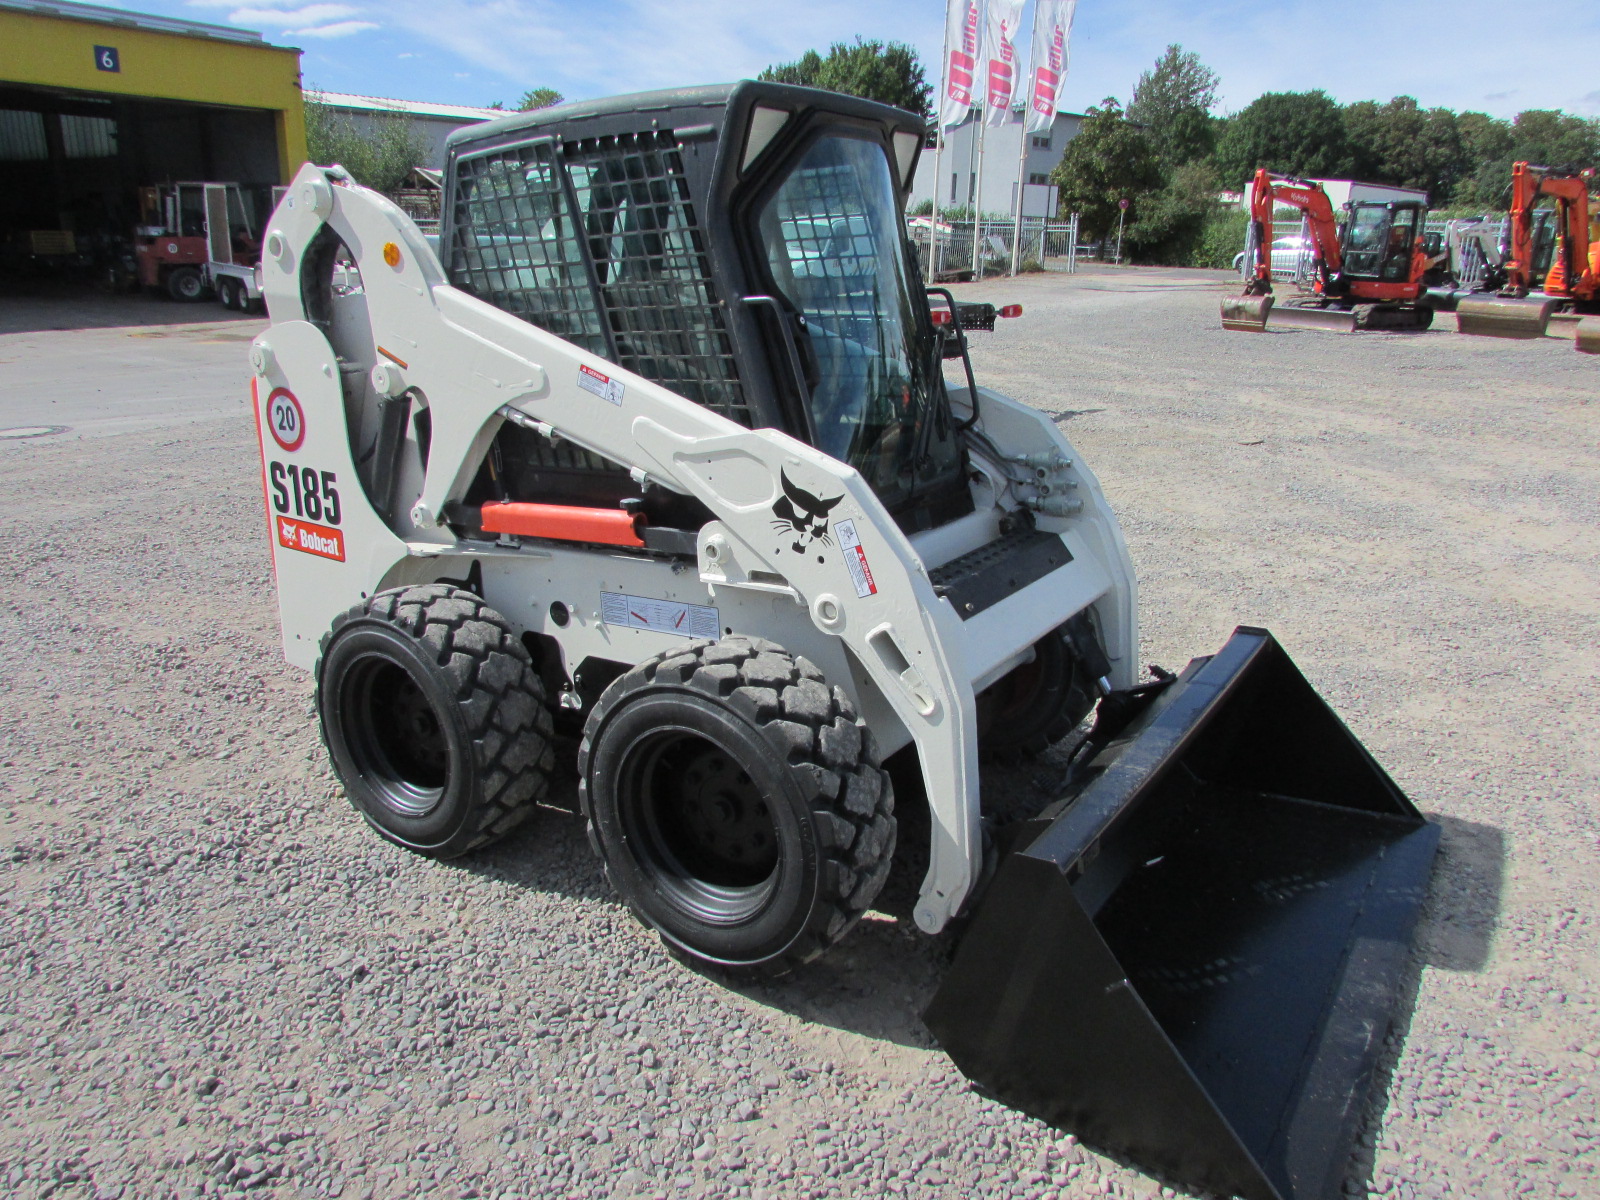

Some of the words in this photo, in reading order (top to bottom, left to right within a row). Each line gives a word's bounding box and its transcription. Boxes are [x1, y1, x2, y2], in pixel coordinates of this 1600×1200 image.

[103, 51, 114, 68] 6
[276, 405, 296, 432] 20
[270, 460, 342, 525] S185
[300, 528, 340, 556] Bobcat
[861, 560, 873, 586] GEFAHR
